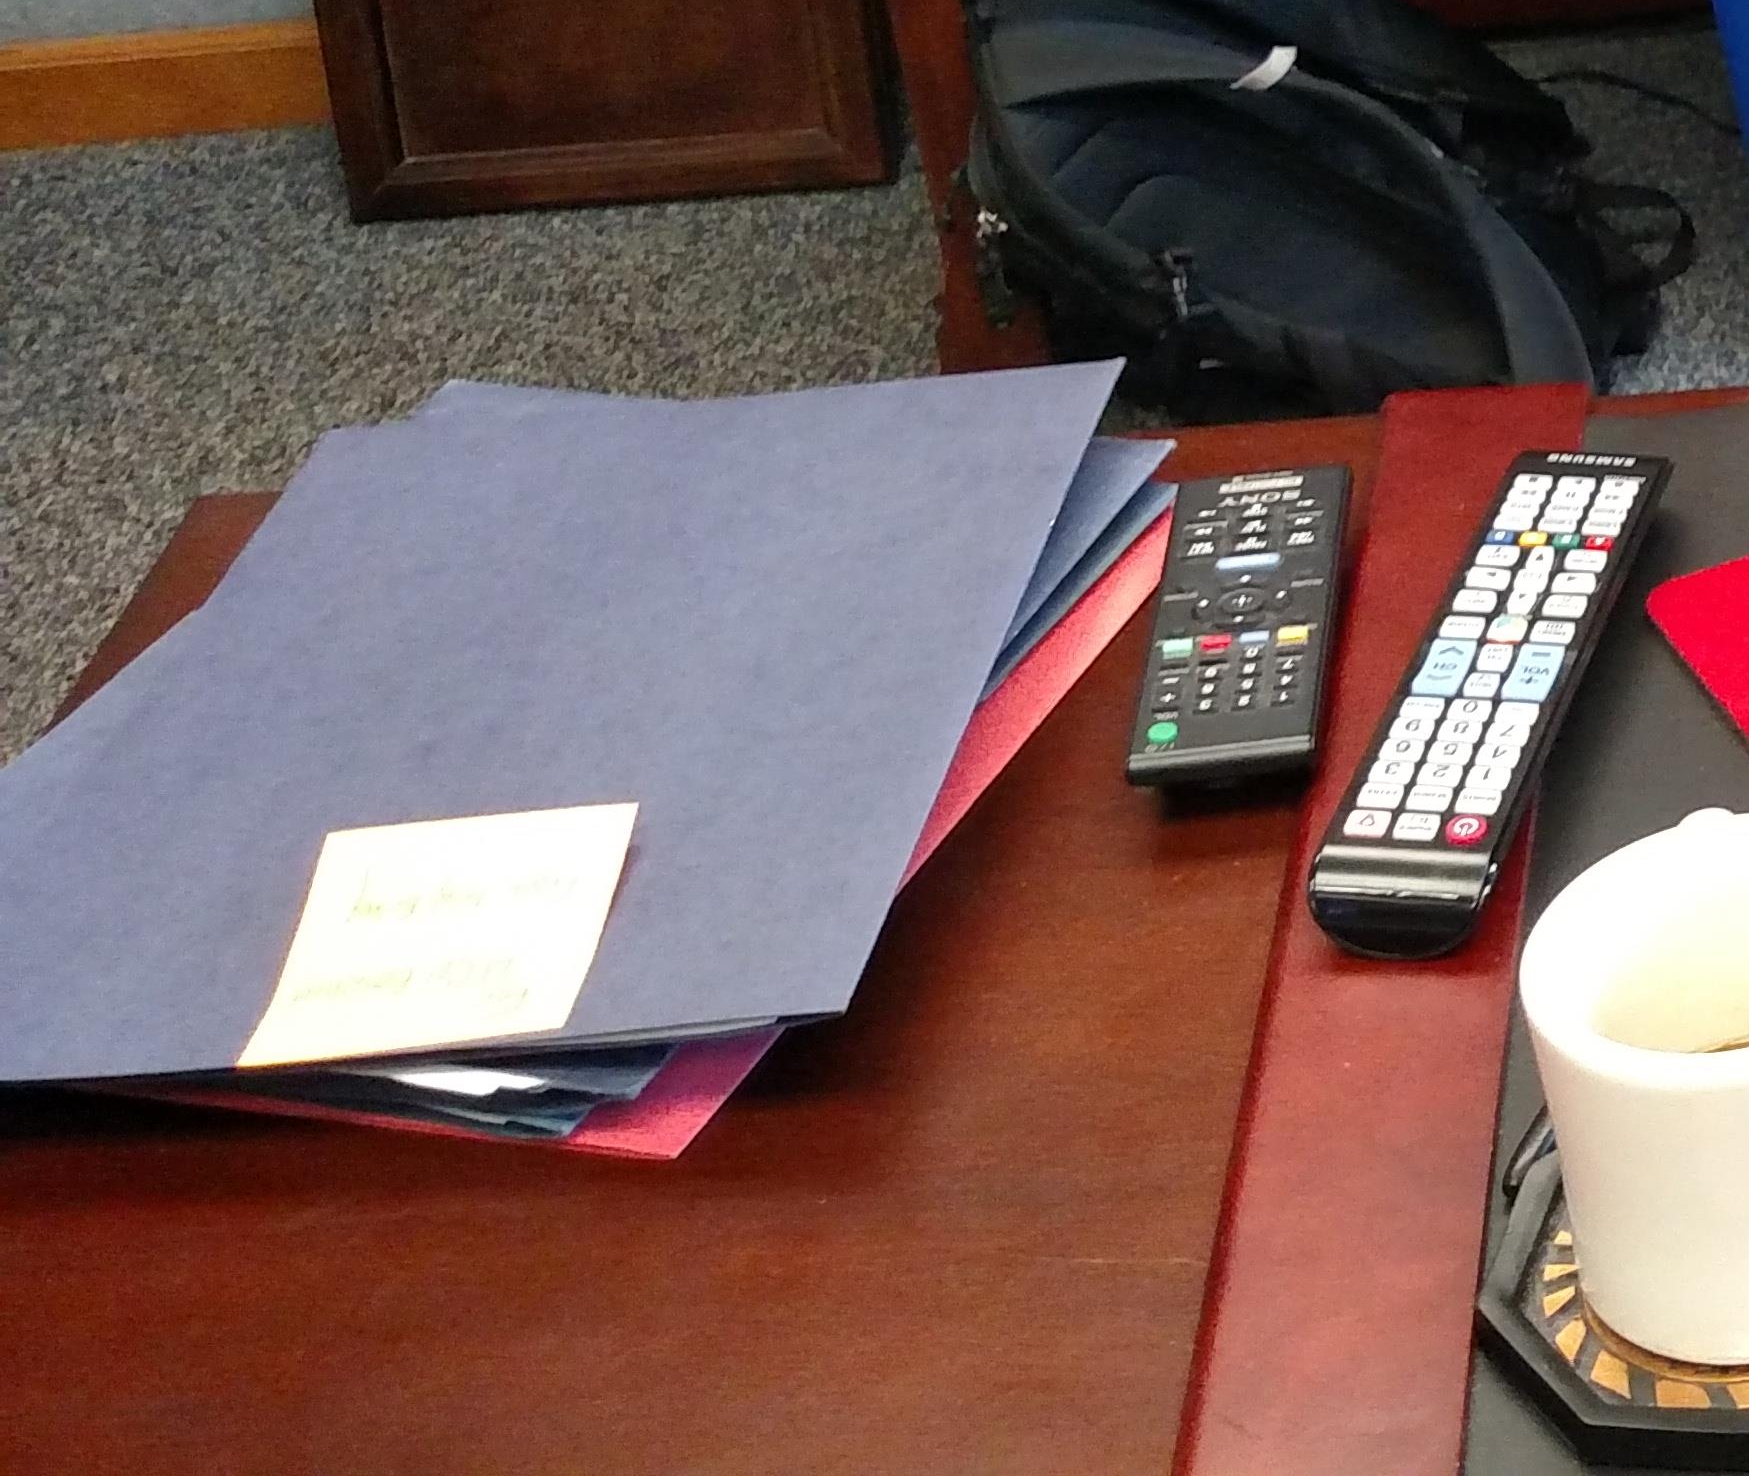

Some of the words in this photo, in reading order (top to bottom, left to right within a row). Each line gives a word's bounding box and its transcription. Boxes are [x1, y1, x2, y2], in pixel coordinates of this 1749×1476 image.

[1546, 452, 1636, 467] SAMSUNG
[1216, 490, 1301, 507] SONY
[1521, 665, 1550, 676] VOL
[1462, 700, 1479, 713] 0
[1405, 719, 1420, 731] 9
[1454, 722, 1469, 734] 8
[1500, 725, 1514, 737] 7
[1492, 746, 1507, 758] 4
[1385, 762, 1400, 775] 3
[1433, 765, 1450, 777] 2
[1483, 768, 1491, 780] 1
